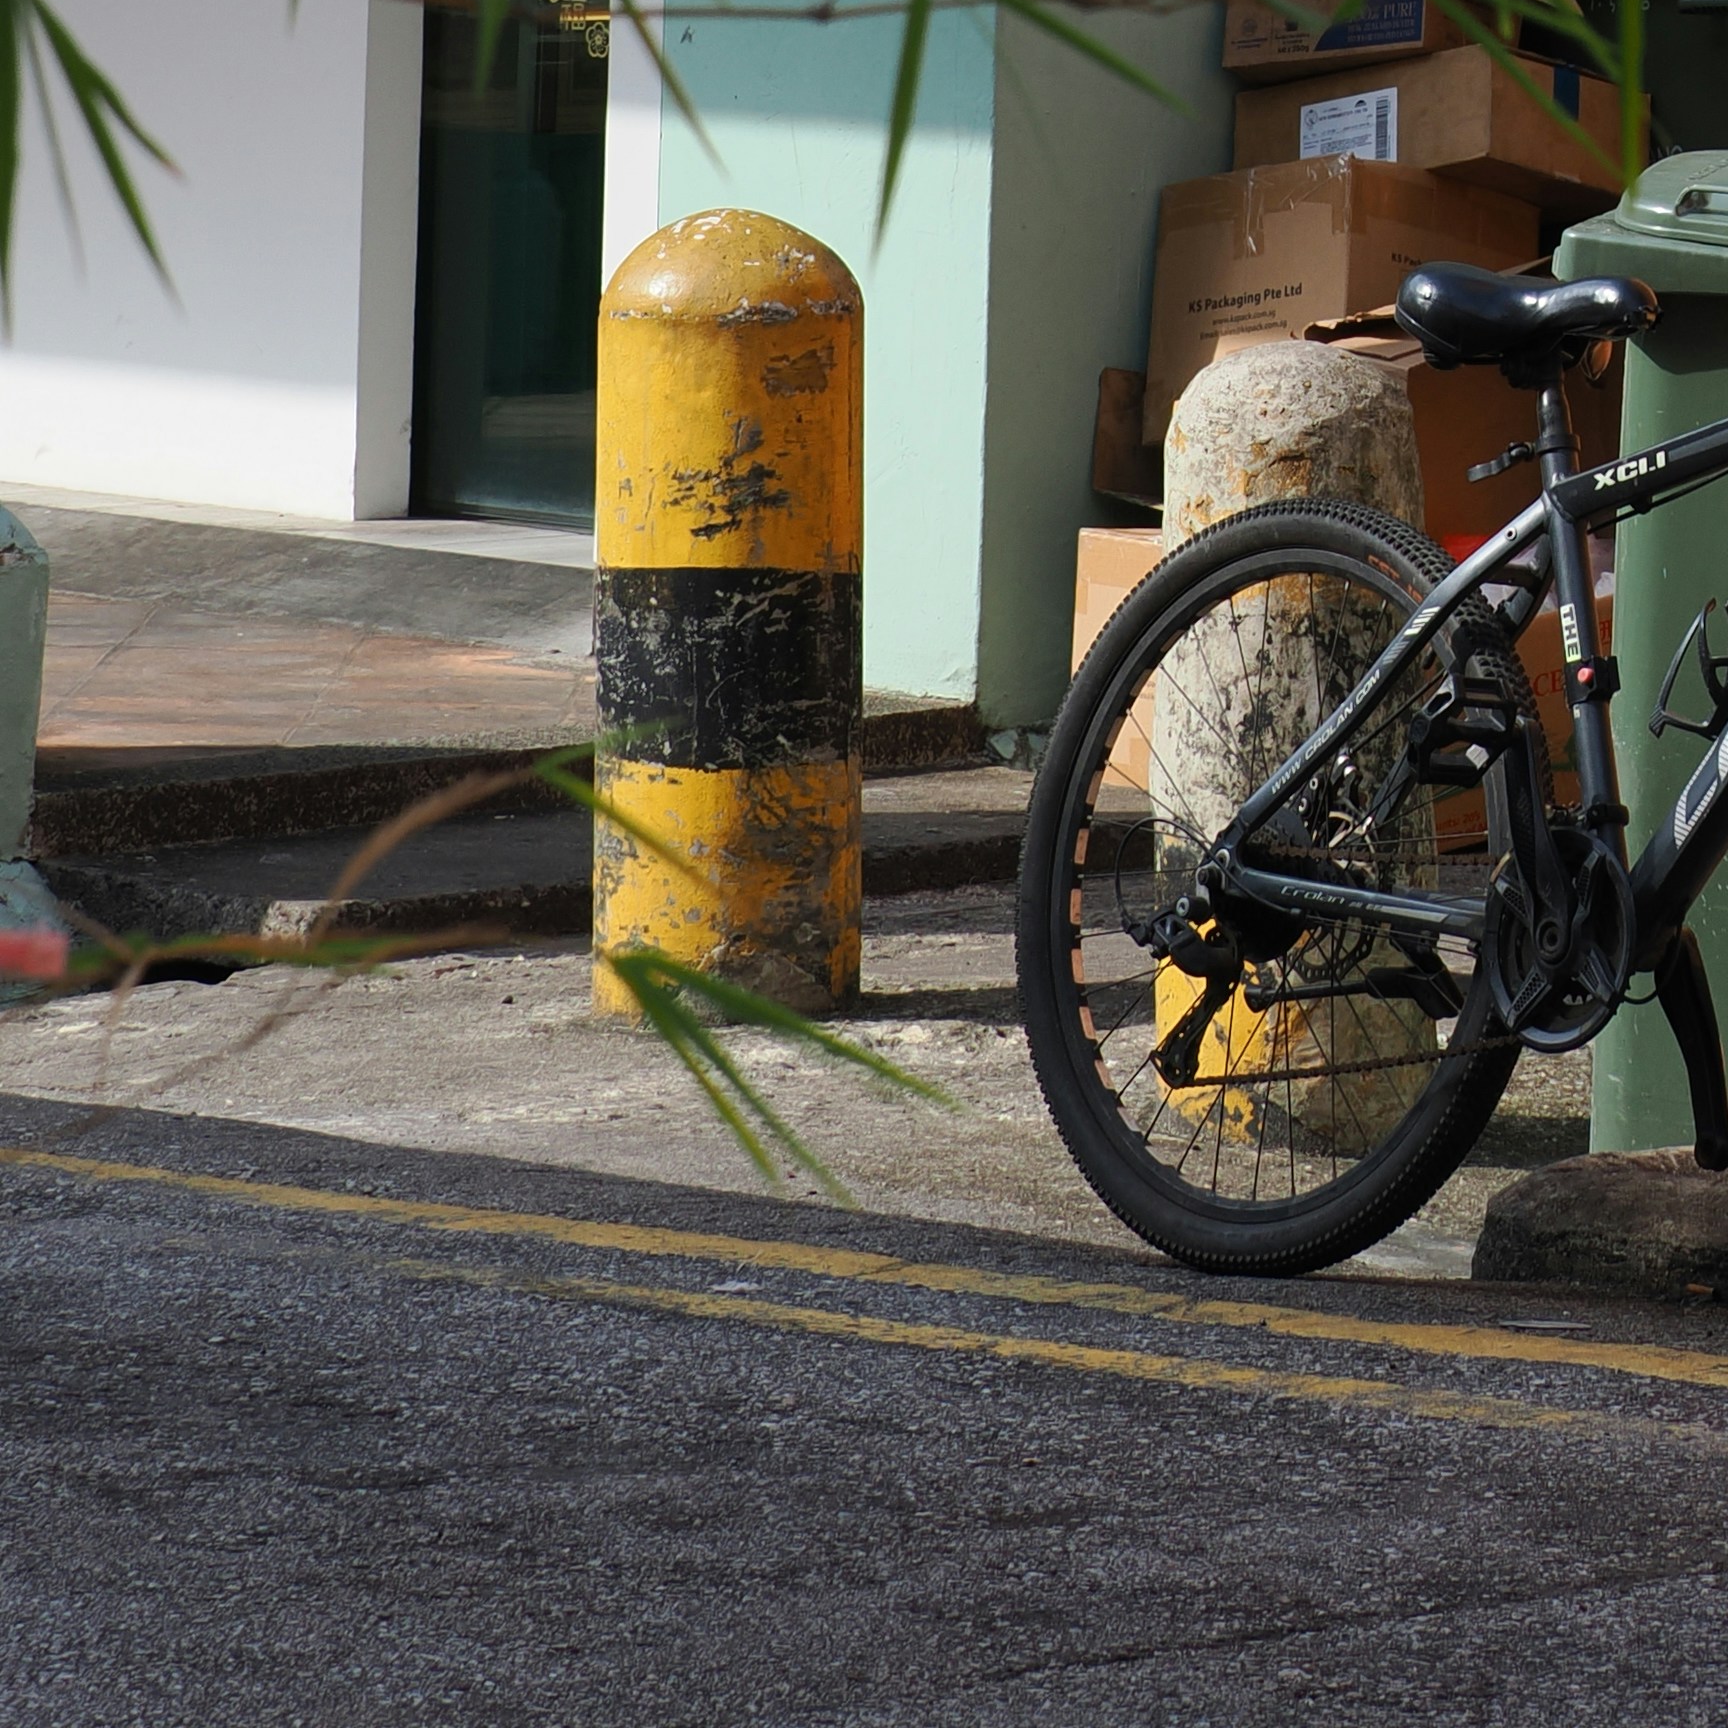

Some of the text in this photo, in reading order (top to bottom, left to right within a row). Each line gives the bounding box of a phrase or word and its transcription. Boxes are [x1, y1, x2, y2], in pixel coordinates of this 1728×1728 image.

[1188, 282, 1303, 314] KS Packaging Pte Ltd
[1561, 606, 1580, 658] THE
